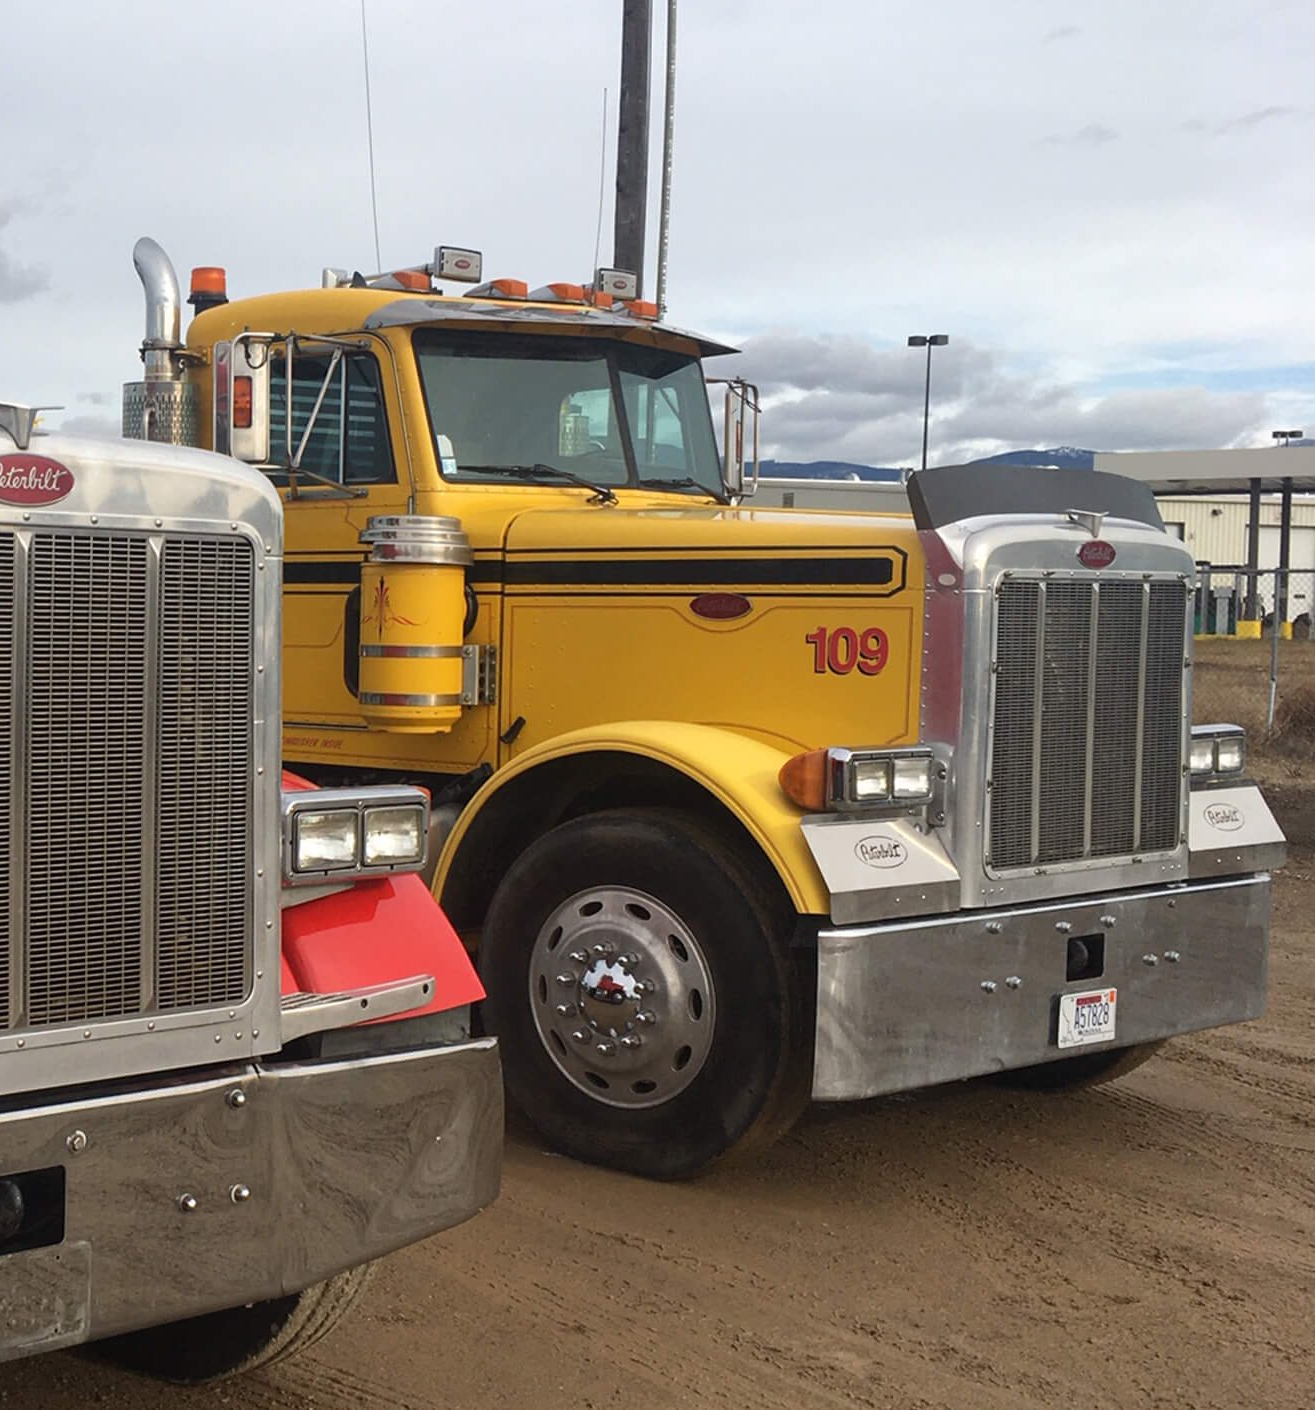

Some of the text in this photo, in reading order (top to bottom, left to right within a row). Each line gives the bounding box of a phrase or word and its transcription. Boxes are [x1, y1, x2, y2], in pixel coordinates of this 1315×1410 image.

[805, 626, 890, 677] 109
[859, 843, 901, 861] Peterbilt
[1073, 1002, 1110, 1030] A57828
